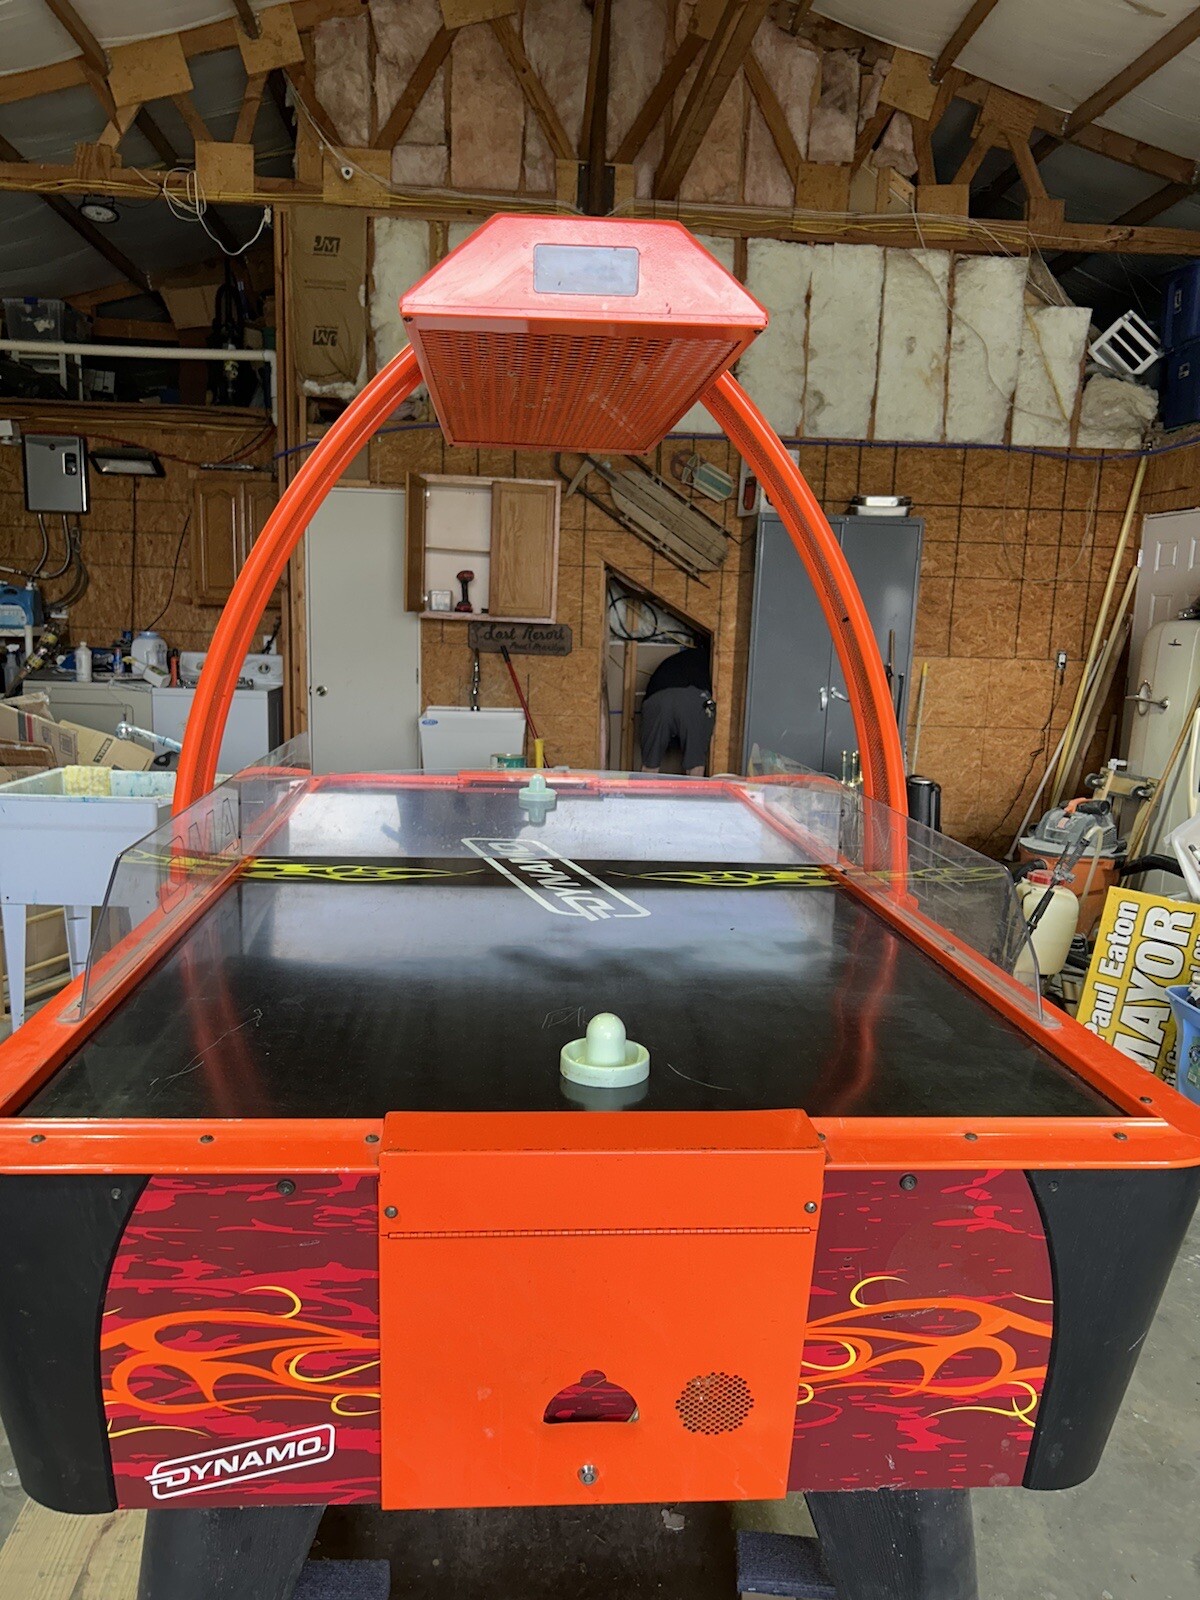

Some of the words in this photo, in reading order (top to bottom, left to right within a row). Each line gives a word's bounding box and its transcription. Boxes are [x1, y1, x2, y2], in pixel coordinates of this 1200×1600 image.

[488, 842, 616, 921] DYNAMO
[1098, 900, 1141, 979] Eaton
[1113, 906, 1196, 1073] MAYOR
[144, 1436, 322, 1488] DYNAMO
